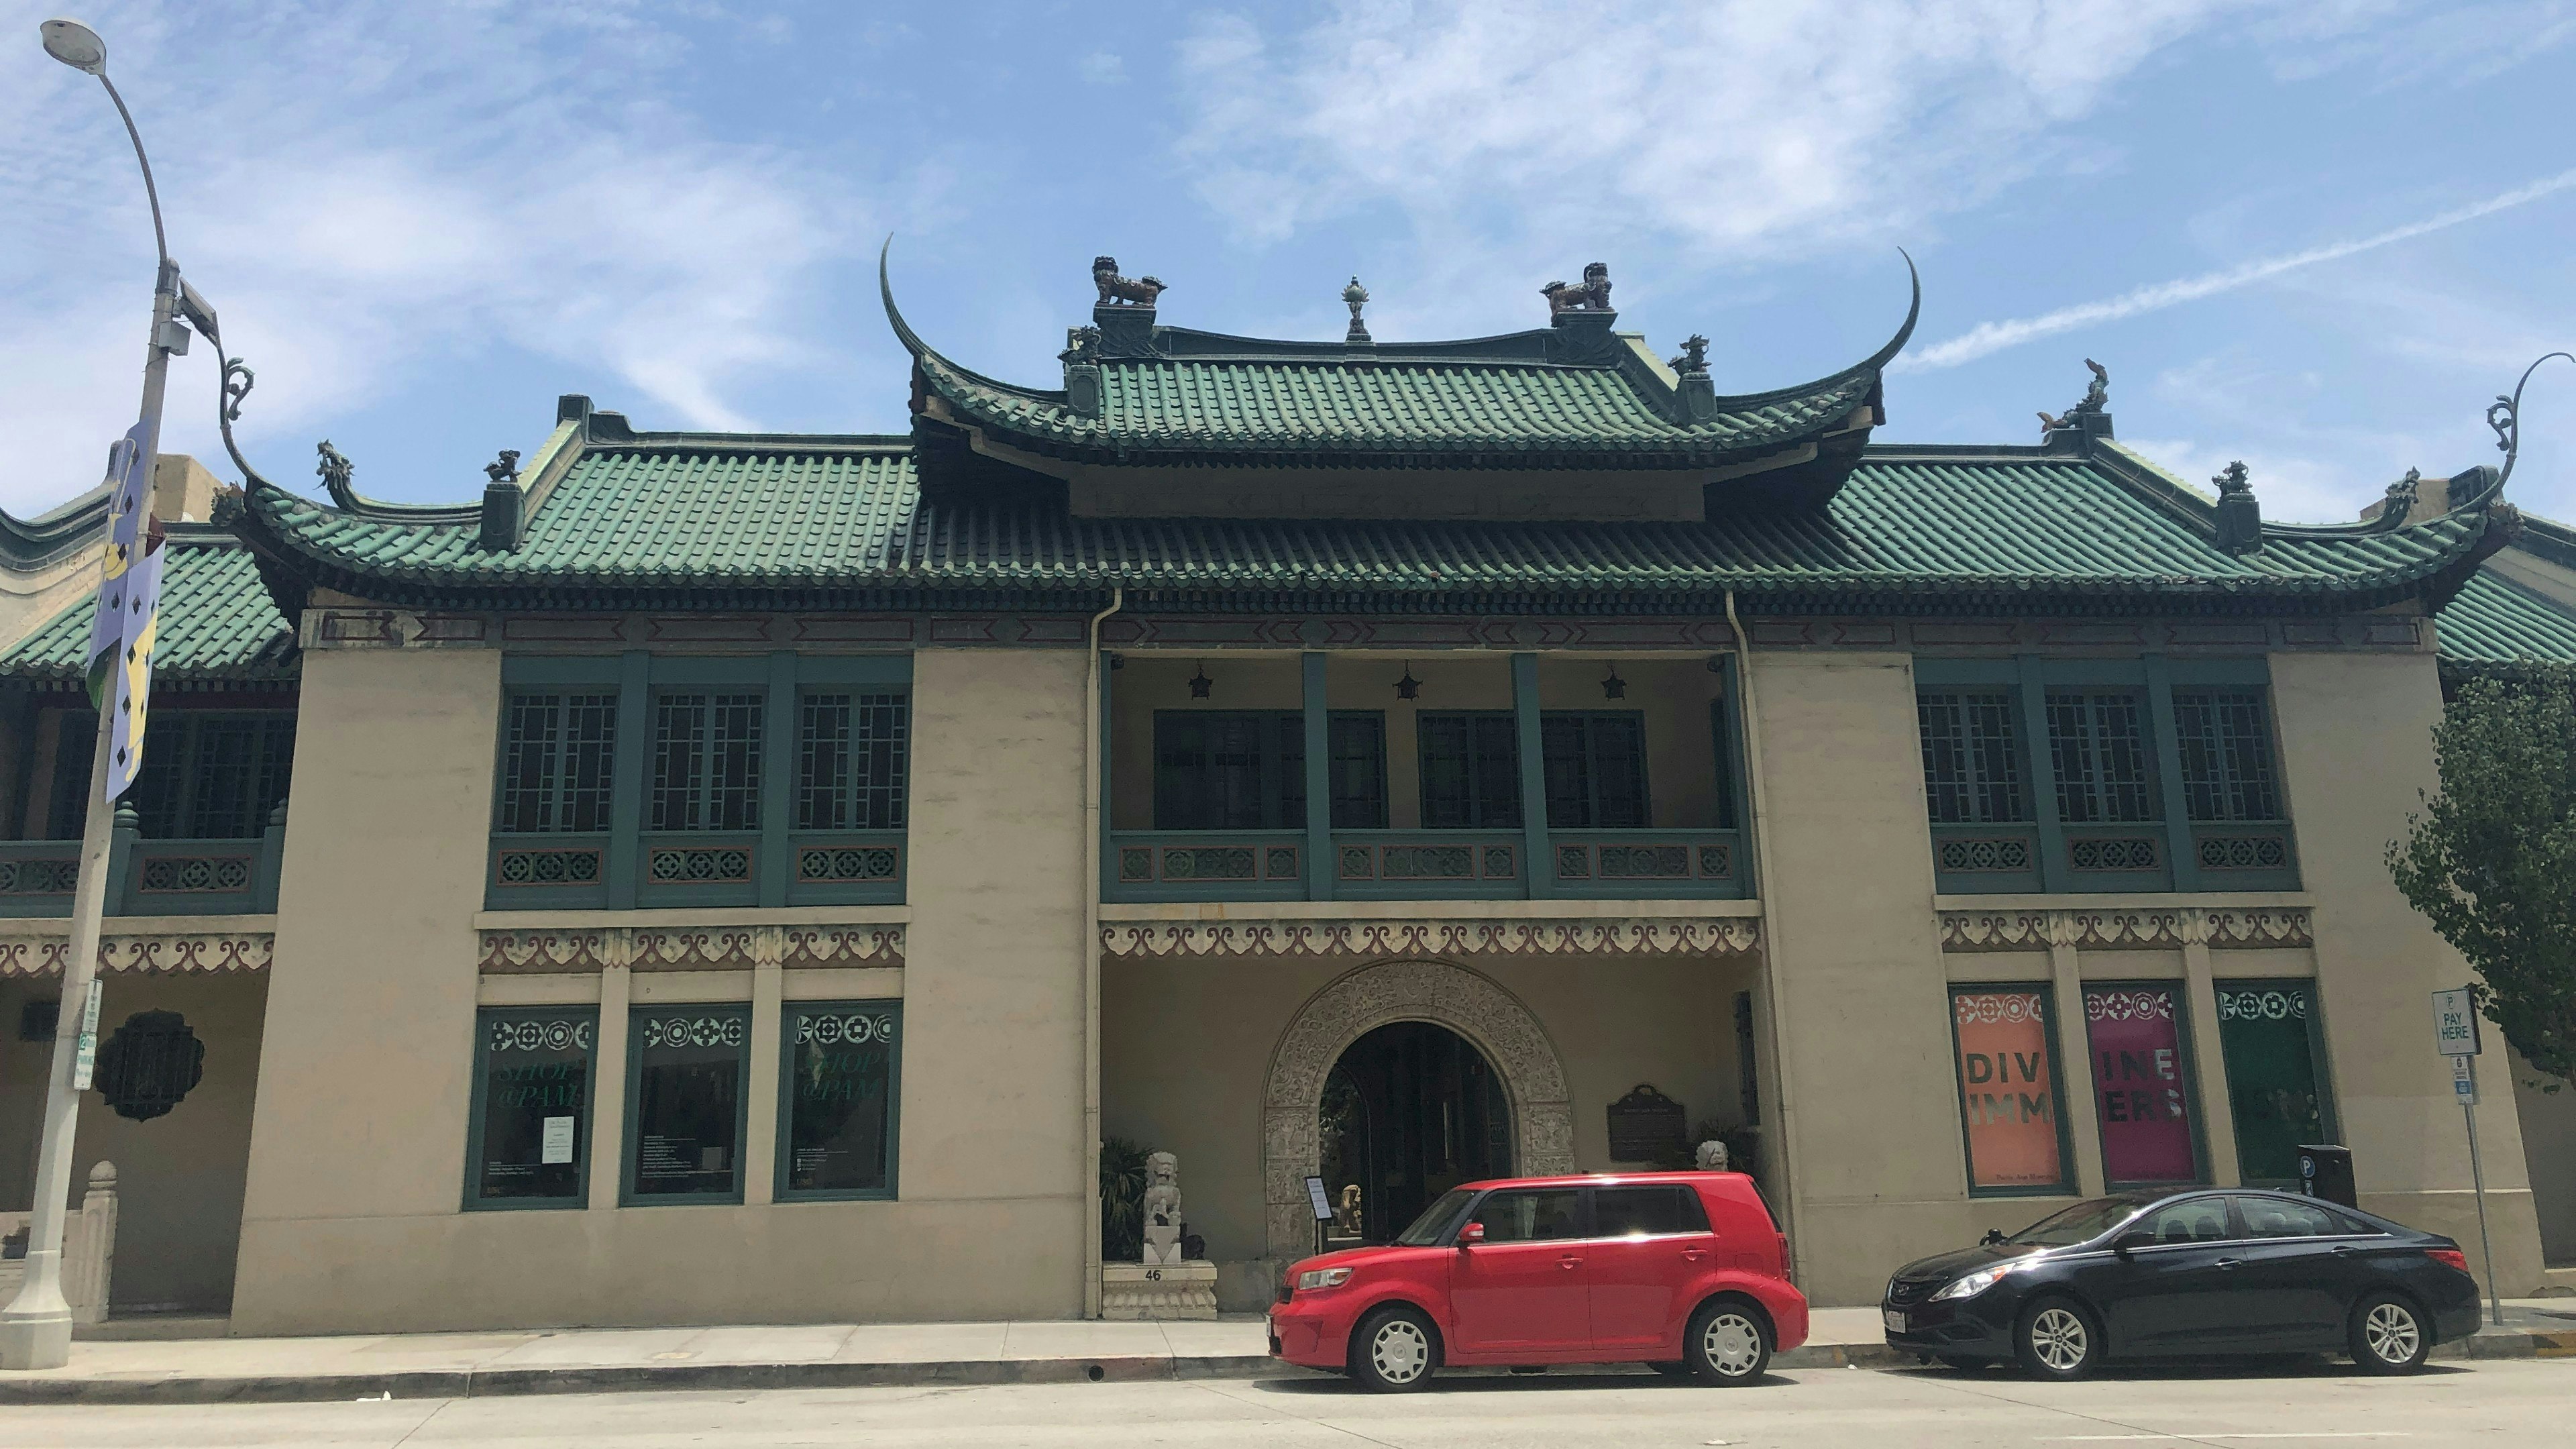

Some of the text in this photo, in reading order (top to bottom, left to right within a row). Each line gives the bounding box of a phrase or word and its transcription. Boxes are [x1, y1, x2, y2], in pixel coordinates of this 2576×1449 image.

[2441, 1026, 2469, 1040] HERE
[2443, 1012, 2462, 1026] PAY
[1966, 1052, 2040, 1083] DIV
[2102, 1049, 2175, 1081] INE
[1970, 1091, 2050, 1126] IMM
[2105, 1089, 2182, 1122] ERS
[1145, 1269, 1161, 1281] 46
